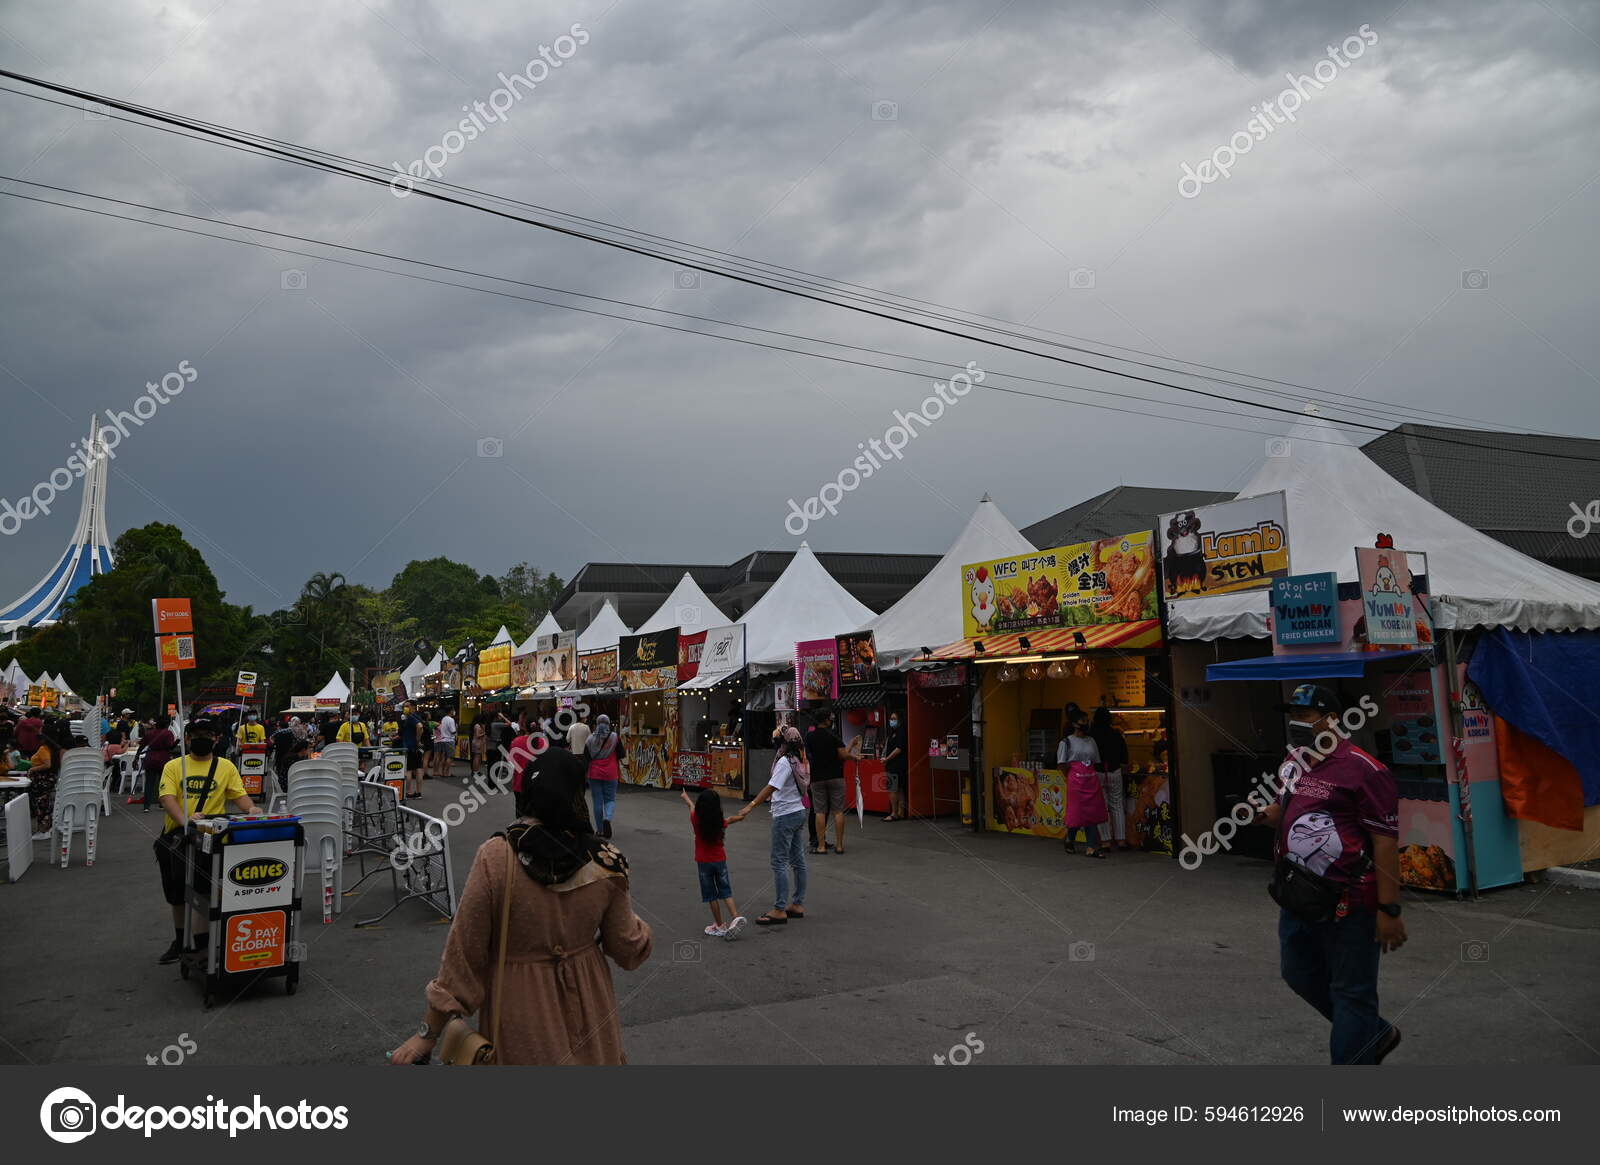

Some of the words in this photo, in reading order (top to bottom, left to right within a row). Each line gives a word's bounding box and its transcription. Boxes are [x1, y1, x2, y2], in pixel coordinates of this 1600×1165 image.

[1202, 525, 1282, 560] Lamb
[993, 561, 1017, 576] WFC
[1021, 555, 1056, 571] 叫了个鸡
[1211, 554, 1264, 581] STEW
[1079, 596, 1091, 604] Fried
[1092, 594, 1112, 603] Chicken
[1277, 603, 1331, 620] YUMMY
[1367, 600, 1411, 618] YUMMY
[1291, 619, 1331, 630] KOREAN
[1303, 630, 1334, 638] CHICKEN
[1463, 715, 1488, 728] UMMY
[234, 863, 283, 881] LEAVES
[255, 887, 265, 895] OF
[235, 919, 254, 942] S
[255, 927, 279, 940] PAY
[231, 938, 279, 952] GLOBAL
